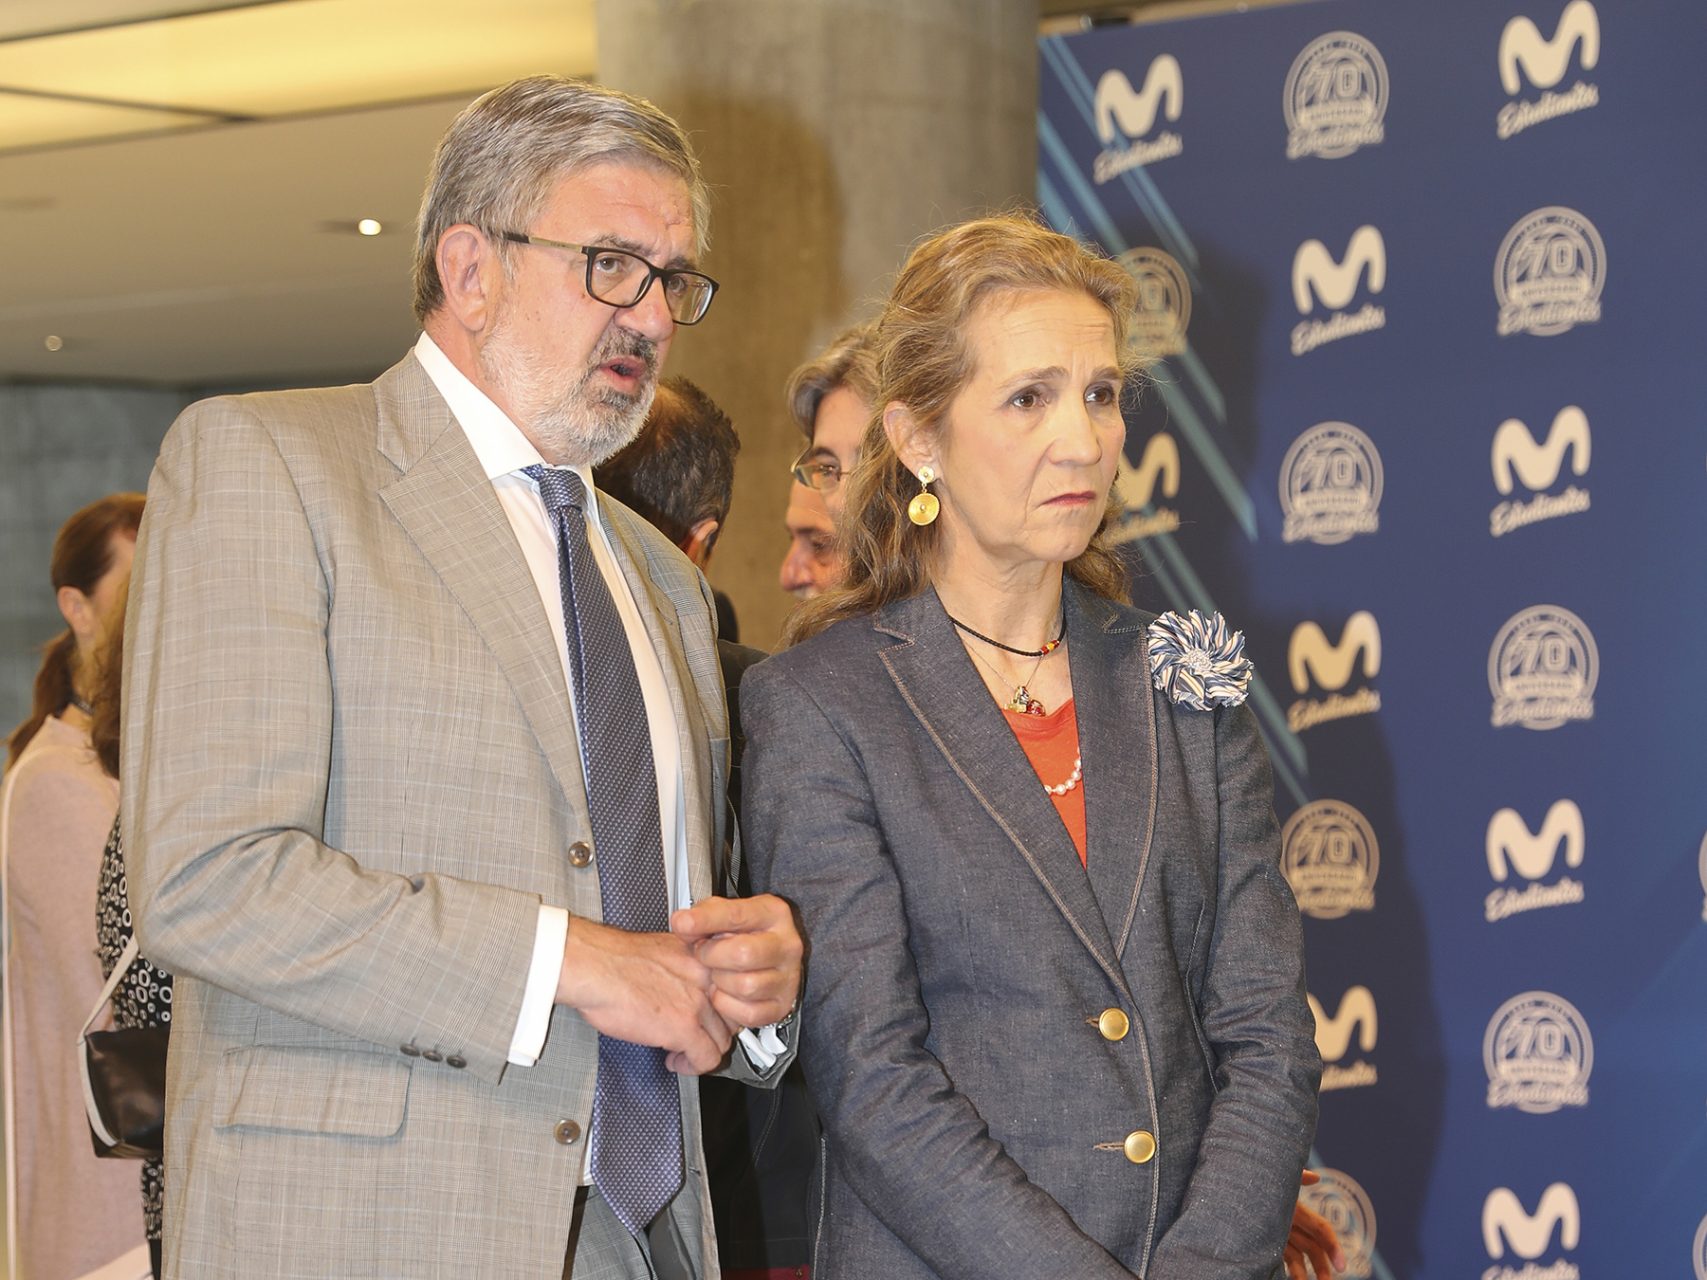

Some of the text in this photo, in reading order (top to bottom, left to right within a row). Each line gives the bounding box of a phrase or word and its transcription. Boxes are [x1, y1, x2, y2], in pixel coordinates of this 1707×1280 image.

[1311, 61, 1361, 102] 70
[1523, 237, 1577, 279] 70
[1308, 451, 1355, 489] 70
[1517, 636, 1571, 675] 70
[1304, 829, 1352, 866] 70
[1511, 1021, 1565, 1060] 70
